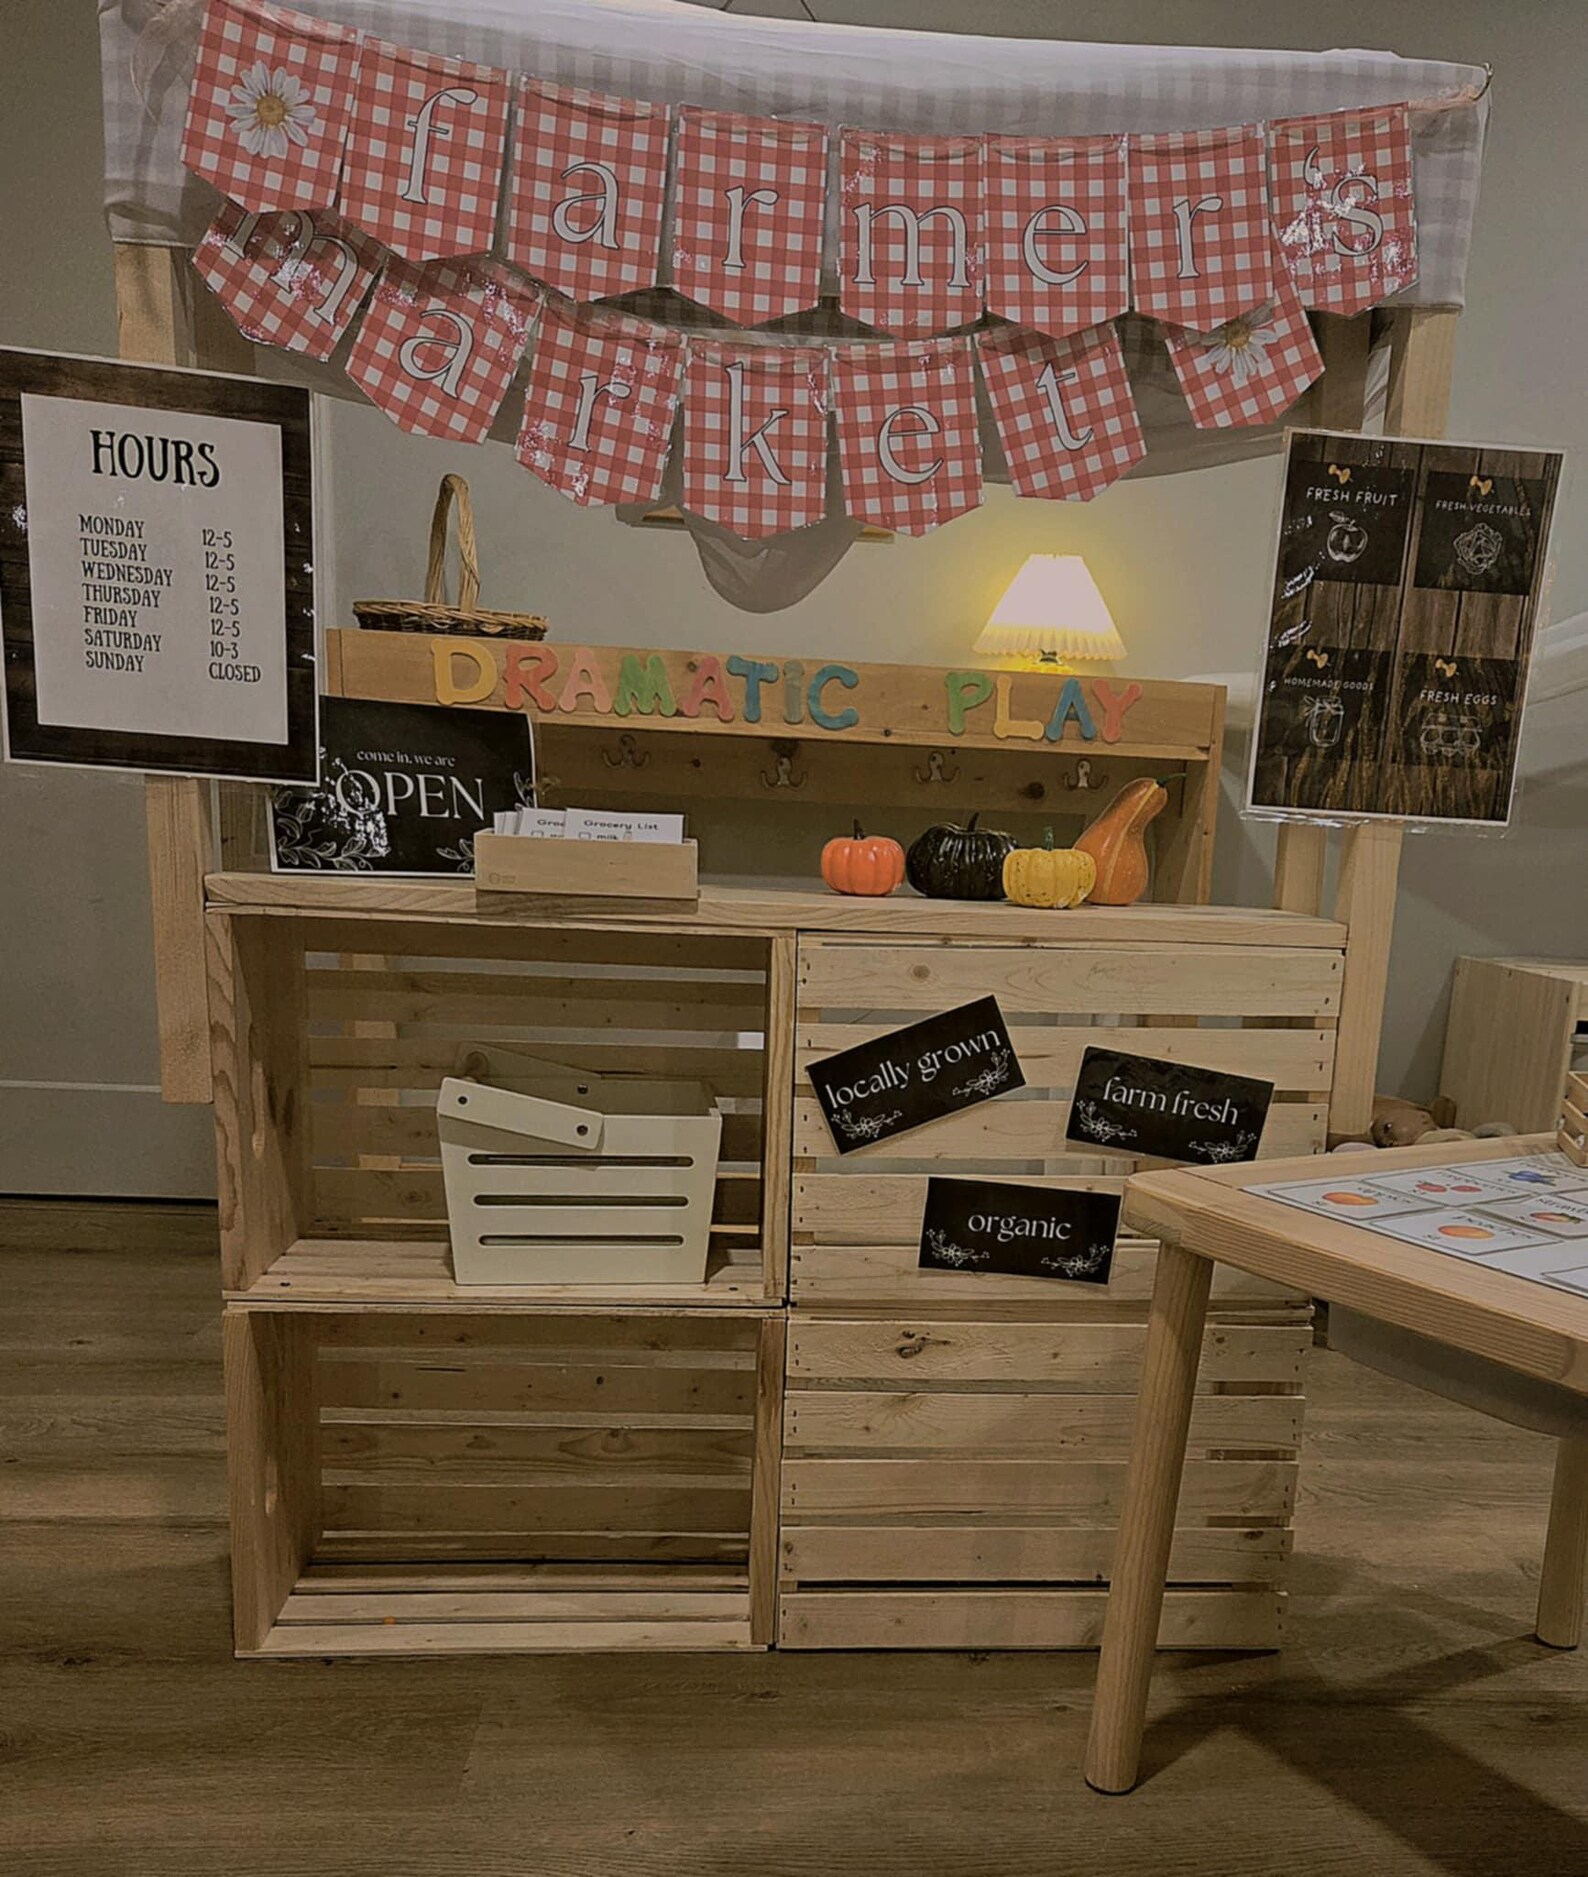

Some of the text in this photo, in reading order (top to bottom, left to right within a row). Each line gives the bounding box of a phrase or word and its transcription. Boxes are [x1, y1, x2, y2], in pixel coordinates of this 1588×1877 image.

[225, 210, 1094, 486] market
[89, 430, 220, 488] HOURS
[1306, 486, 1398, 506] FRESH FRUIT
[1435, 500, 1532, 517] FRESH VEGETABLES
[79, 514, 232, 548] MONDAY 12-5
[80, 537, 235, 571] TUESDAY 12-5
[81, 560, 235, 593] WEDNESDAY 12-5
[82, 583, 239, 615] THURSDAY 12-5
[83, 605, 240, 637] FRIDAY 12-5
[84, 628, 239, 659] SATURDAY 10-3
[85, 651, 261, 683] SUNDAY CLOSED
[431, 637, 1143, 744] DRAMATIC PLAY
[1284, 677, 1374, 691] HOMEMADE GOODS
[1420, 689, 1498, 706] FRESH EGGS
[356, 751, 395, 763] come
[415, 754, 433, 766] we
[434, 757, 456, 768] are
[335, 769, 485, 821] OPEN
[584, 819, 632, 830] Grocery
[824, 1028, 1001, 1110] locally grown
[1103, 1075, 1239, 1126] farm fresh
[967, 1211, 1072, 1243] organic
